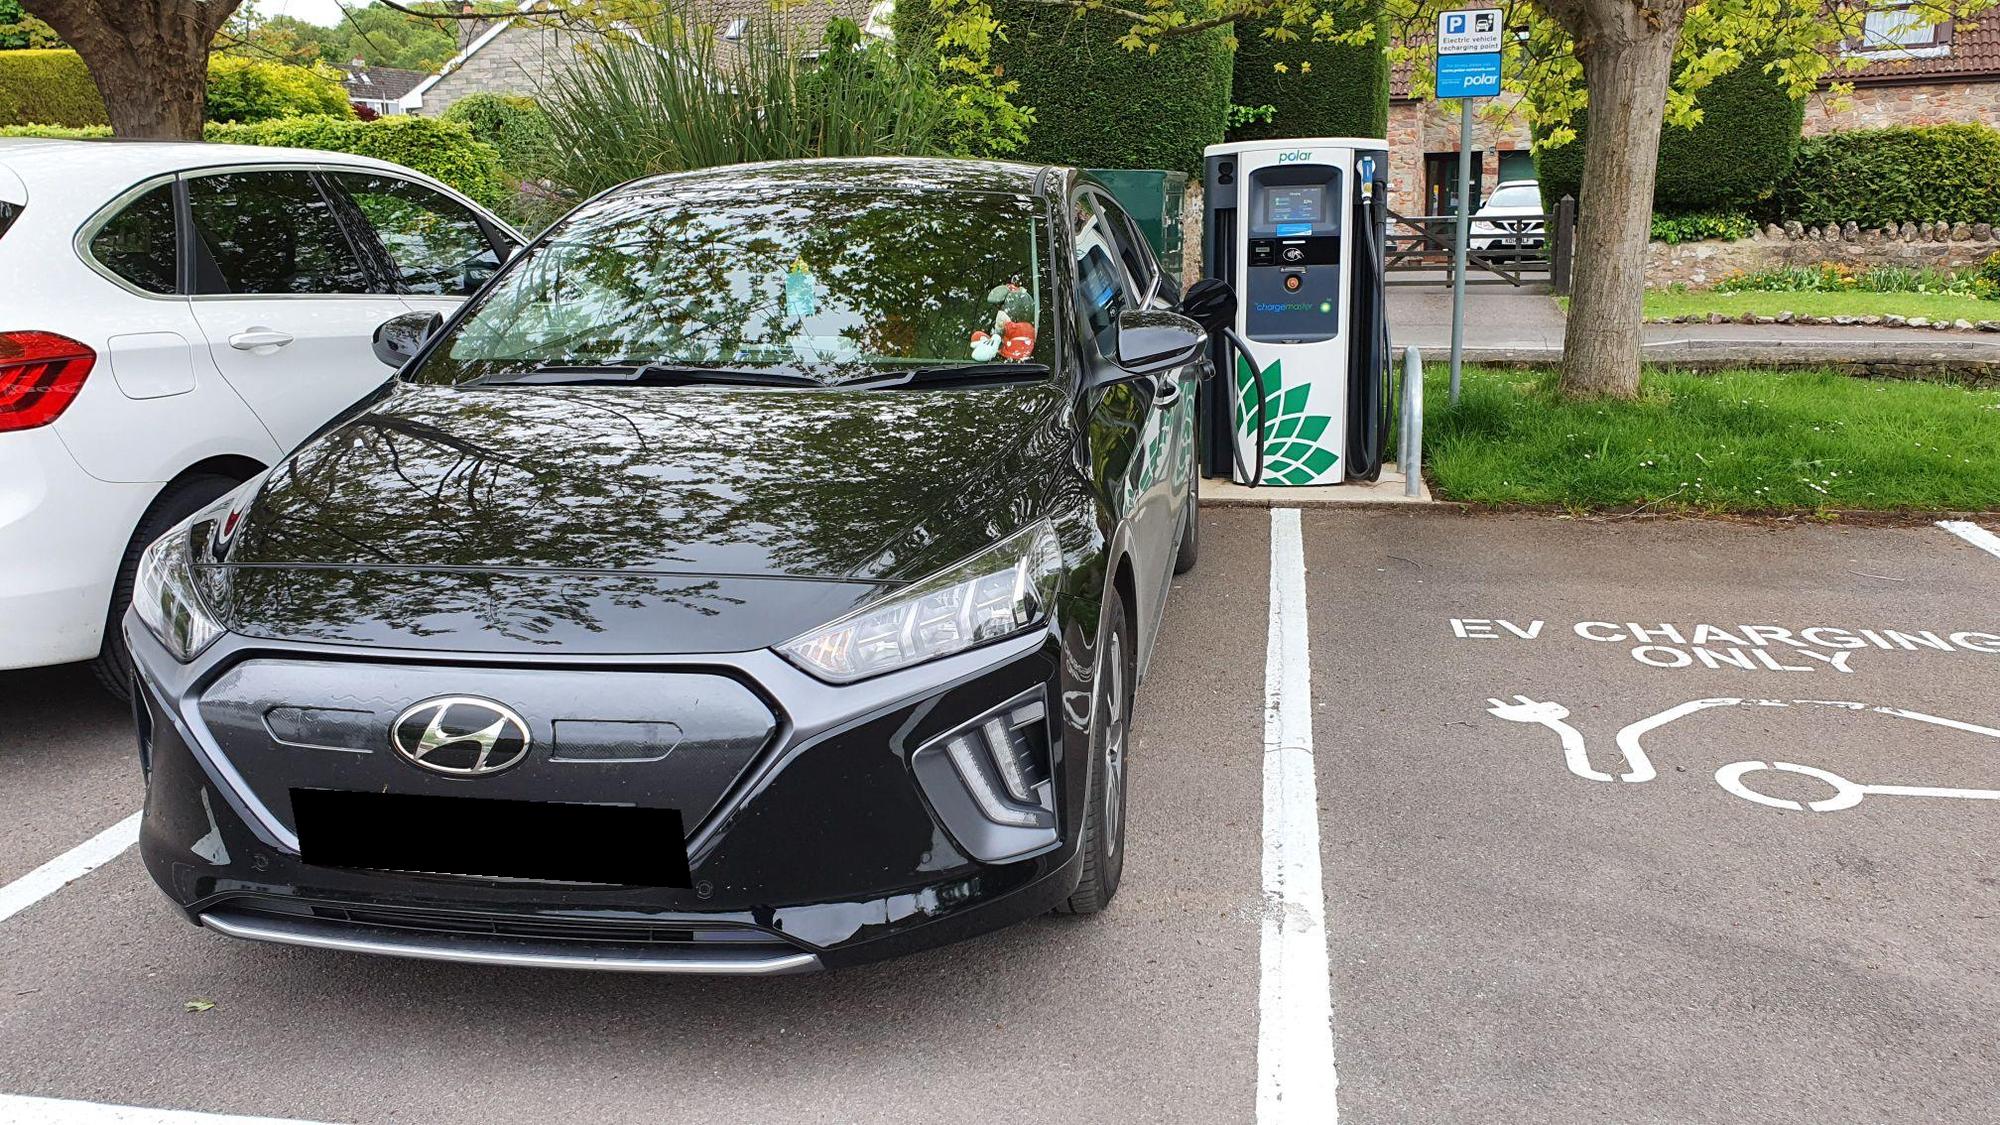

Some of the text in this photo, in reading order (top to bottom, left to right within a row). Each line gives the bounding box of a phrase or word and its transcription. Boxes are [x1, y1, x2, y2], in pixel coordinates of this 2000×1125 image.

[1449, 16, 1463, 33] P
[1464, 73, 1499, 88] polar
[1278, 149, 1312, 164] polar
[1449, 618, 2000, 652] EV CHARGING
[1631, 645, 1855, 673] ONLY
